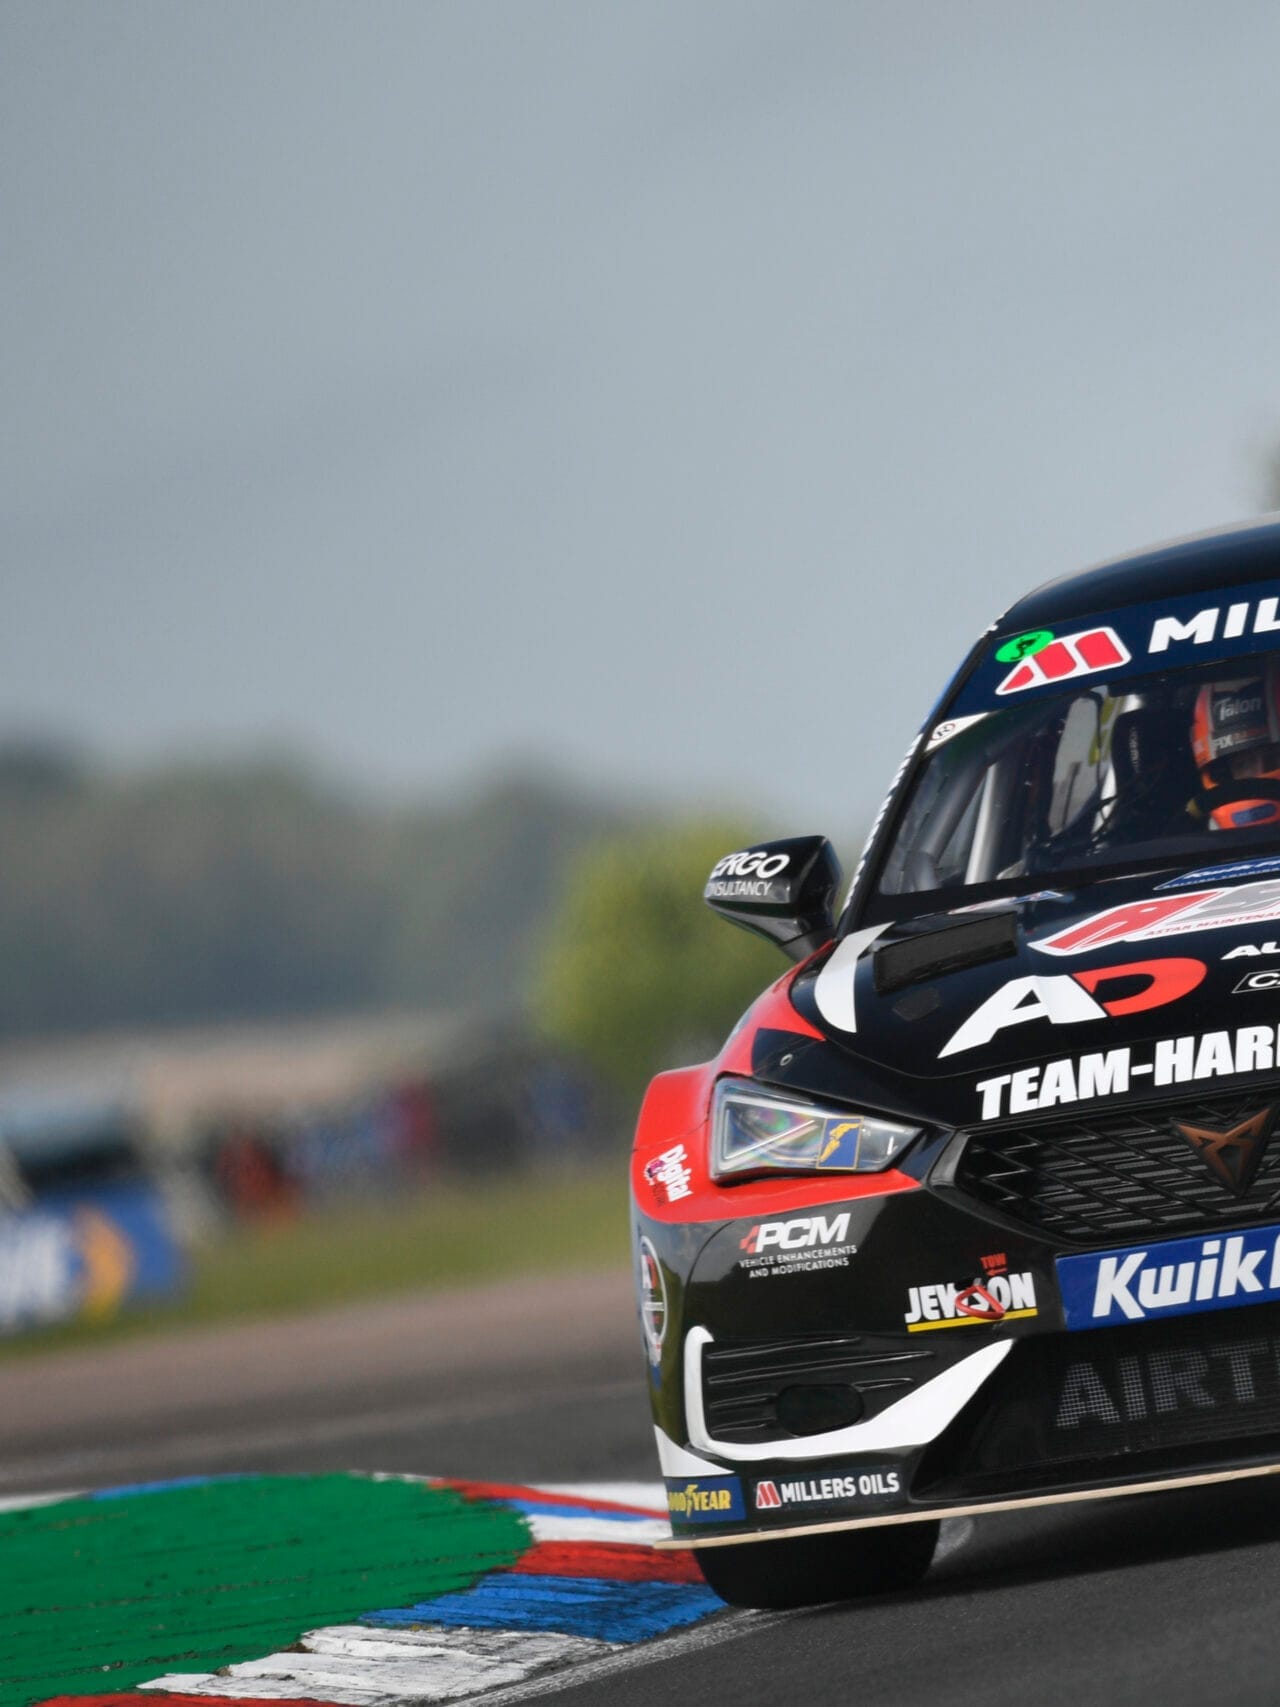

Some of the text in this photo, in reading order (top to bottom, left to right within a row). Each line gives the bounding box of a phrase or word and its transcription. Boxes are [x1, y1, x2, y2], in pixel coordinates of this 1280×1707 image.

[710, 852, 790, 878] ERGO
[659, 1144, 694, 1202] Digital
[755, 1213, 852, 1253] PCM
[739, 1245, 858, 1269] VEHICLE ENHANCEMENTS
[749, 1257, 850, 1278] AND MODIFICATIONS
[781, 1472, 900, 1503] MILLERS OILS
